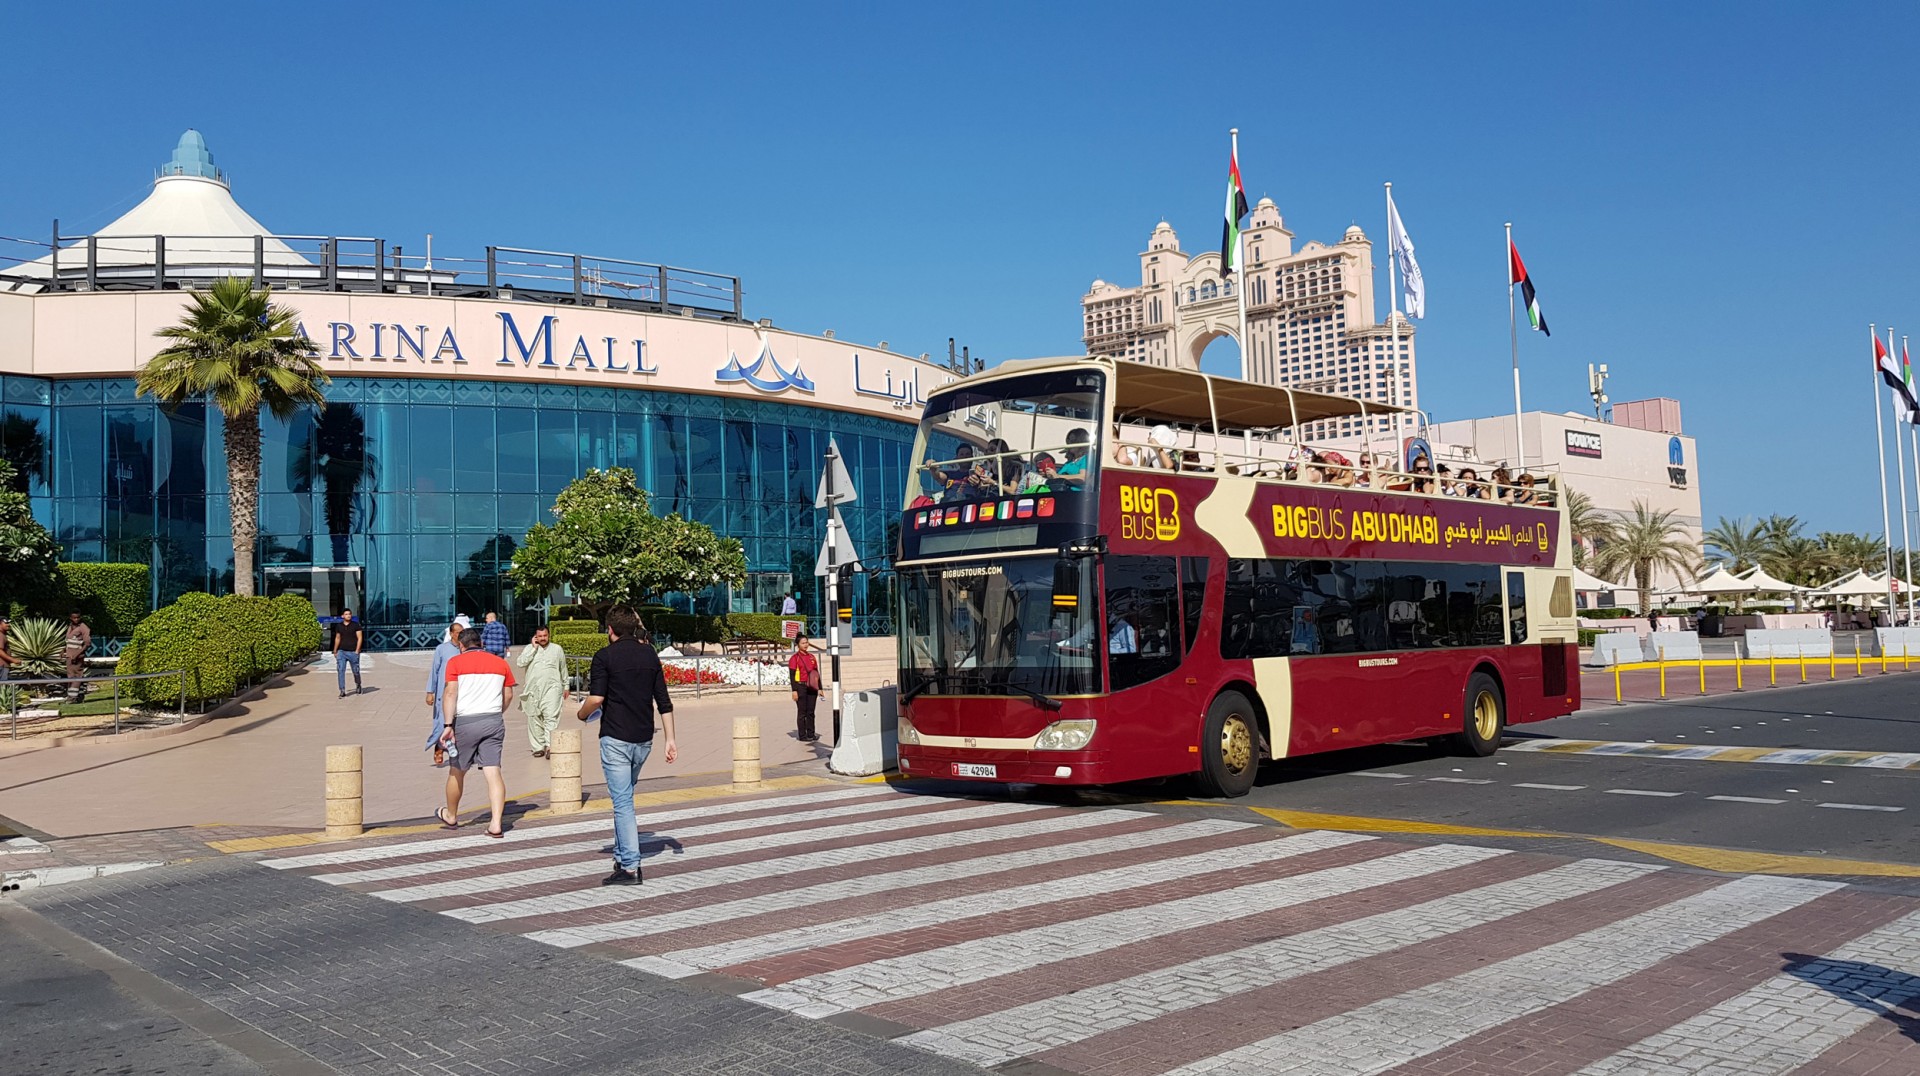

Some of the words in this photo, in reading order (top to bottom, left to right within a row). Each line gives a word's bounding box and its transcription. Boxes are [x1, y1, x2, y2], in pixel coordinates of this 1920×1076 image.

[246, 303, 468, 363] ARINA
[1567, 432, 1601, 450] BOUNCE
[1667, 466, 1687, 485] VOX
[1120, 485, 1154, 514] BIG
[1121, 514, 1155, 541] BUS
[1351, 510, 1387, 543] ABU
[1389, 513, 1439, 545] DHABI
[1444, 521, 1468, 548] ظبي
[1470, 516, 1483, 545] أبو
[1485, 523, 1511, 545] الكبير
[1512, 525, 1533, 547] الباص
[942, 566, 1003, 579] BIGBUSTOURS.COM
[971, 766, 994, 776] 42984
